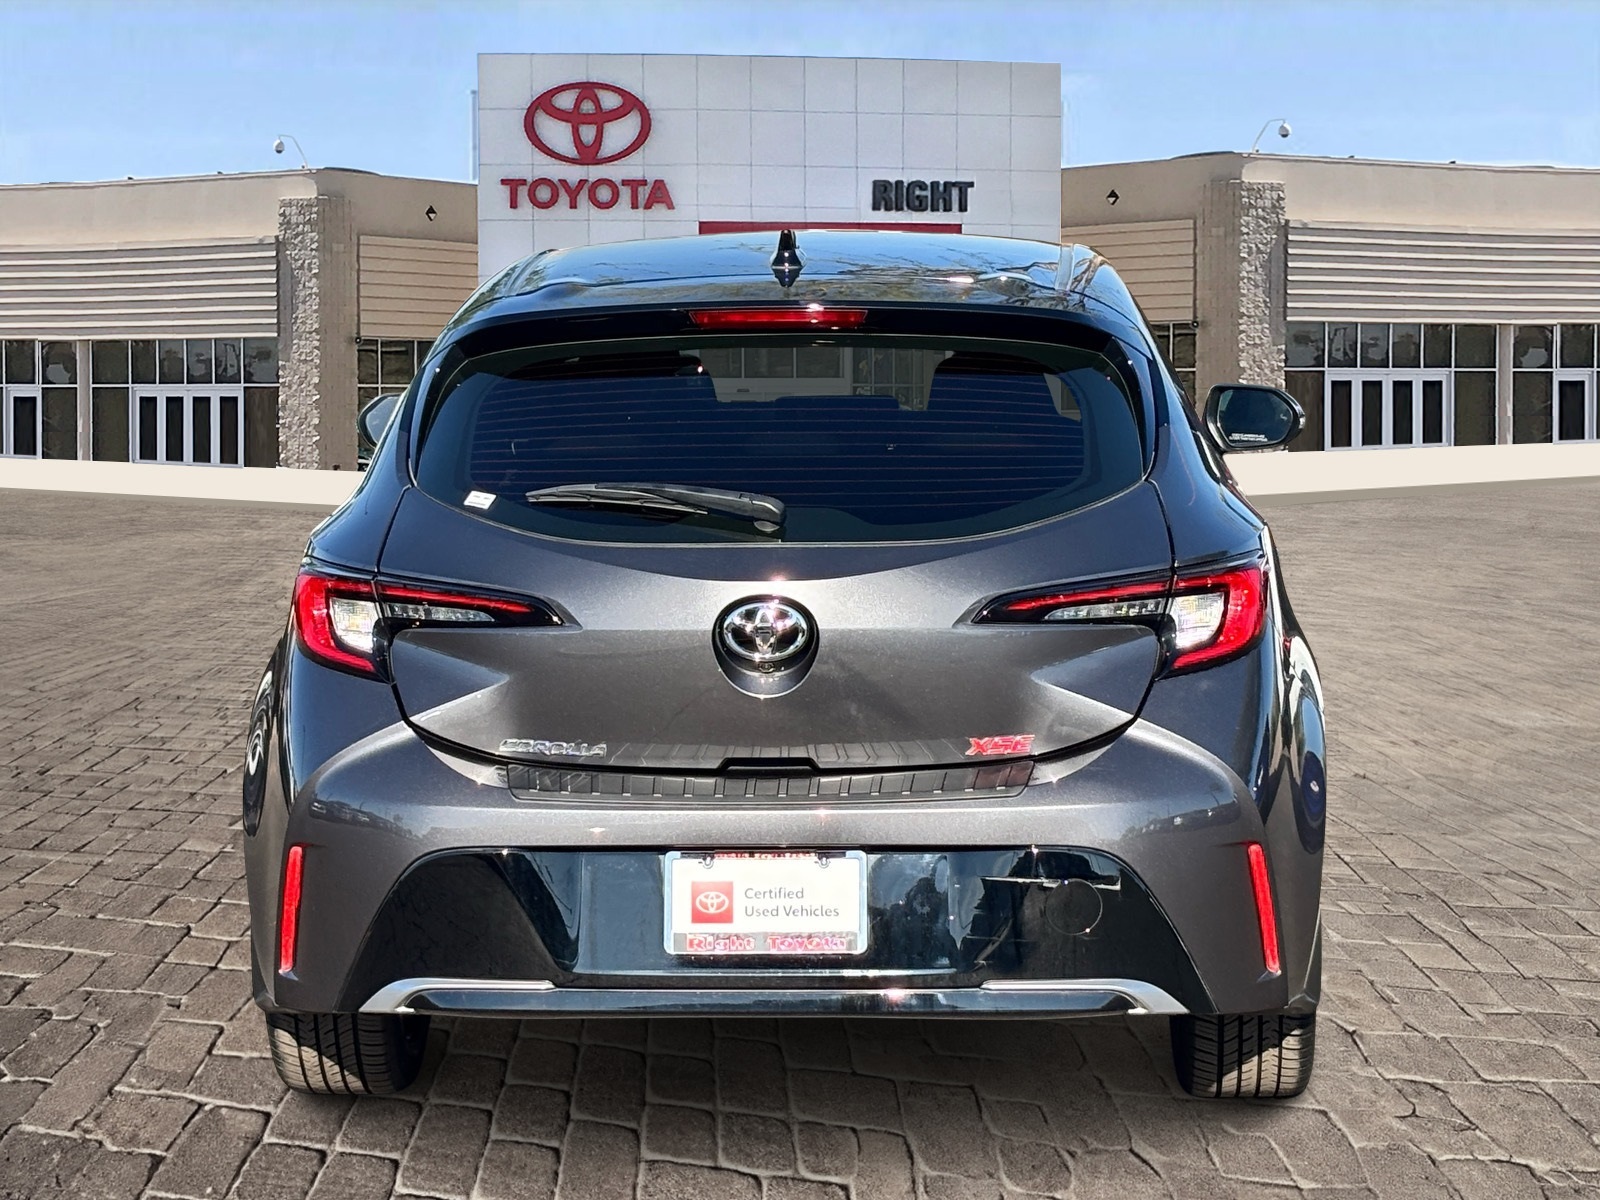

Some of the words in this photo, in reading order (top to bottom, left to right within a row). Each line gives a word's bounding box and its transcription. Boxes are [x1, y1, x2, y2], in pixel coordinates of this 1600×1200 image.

[500, 178, 675, 210] TOYOTA
[872, 180, 975, 213] RIGHT
[965, 735, 1035, 755] XSE
[744, 888, 804, 899] Certified
[744, 905, 779, 917] Used
[783, 905, 840, 917] Vehicles
